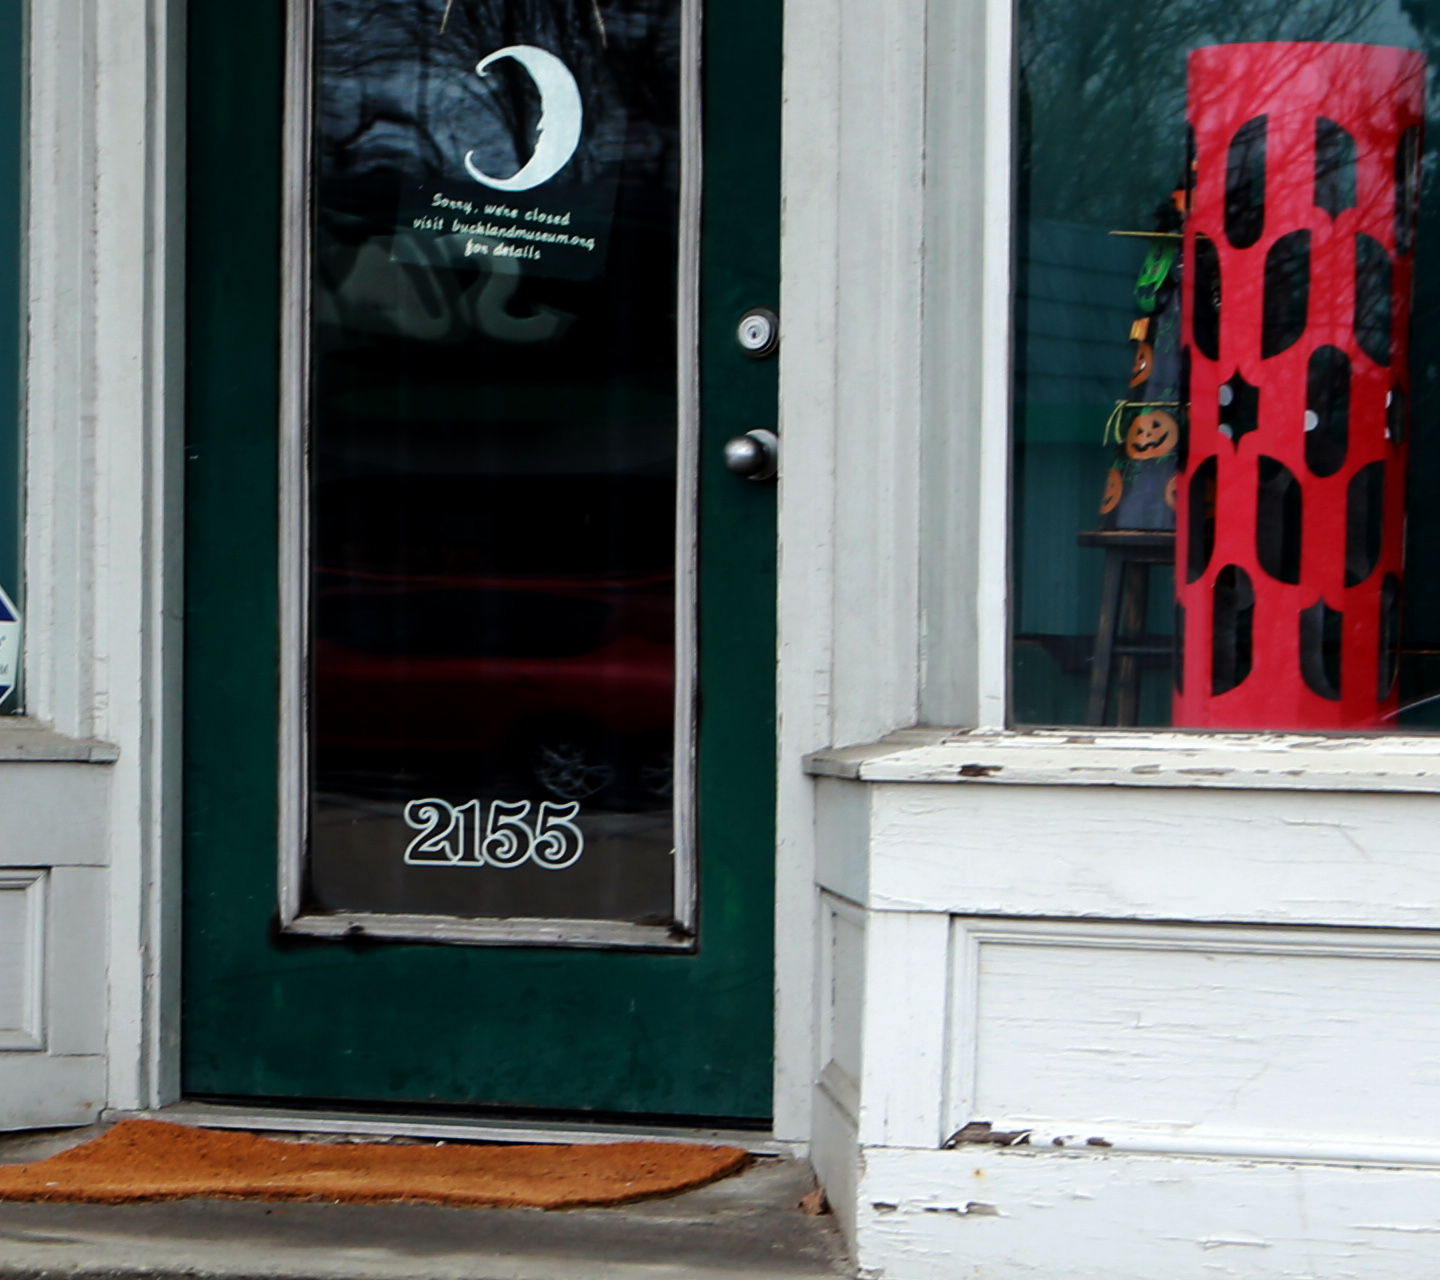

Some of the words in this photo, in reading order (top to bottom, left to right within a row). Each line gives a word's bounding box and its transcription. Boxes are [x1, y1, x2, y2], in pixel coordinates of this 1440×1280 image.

[431, 192, 480, 216] Sorry,
[483, 203, 519, 219] we're
[524, 207, 571, 226] closed
[413, 215, 445, 231] visit
[451, 218, 596, 252] bucklandmuseum.org
[463, 237, 489, 258] for
[492, 241, 542, 261] details
[403, 797, 584, 869] 2155
